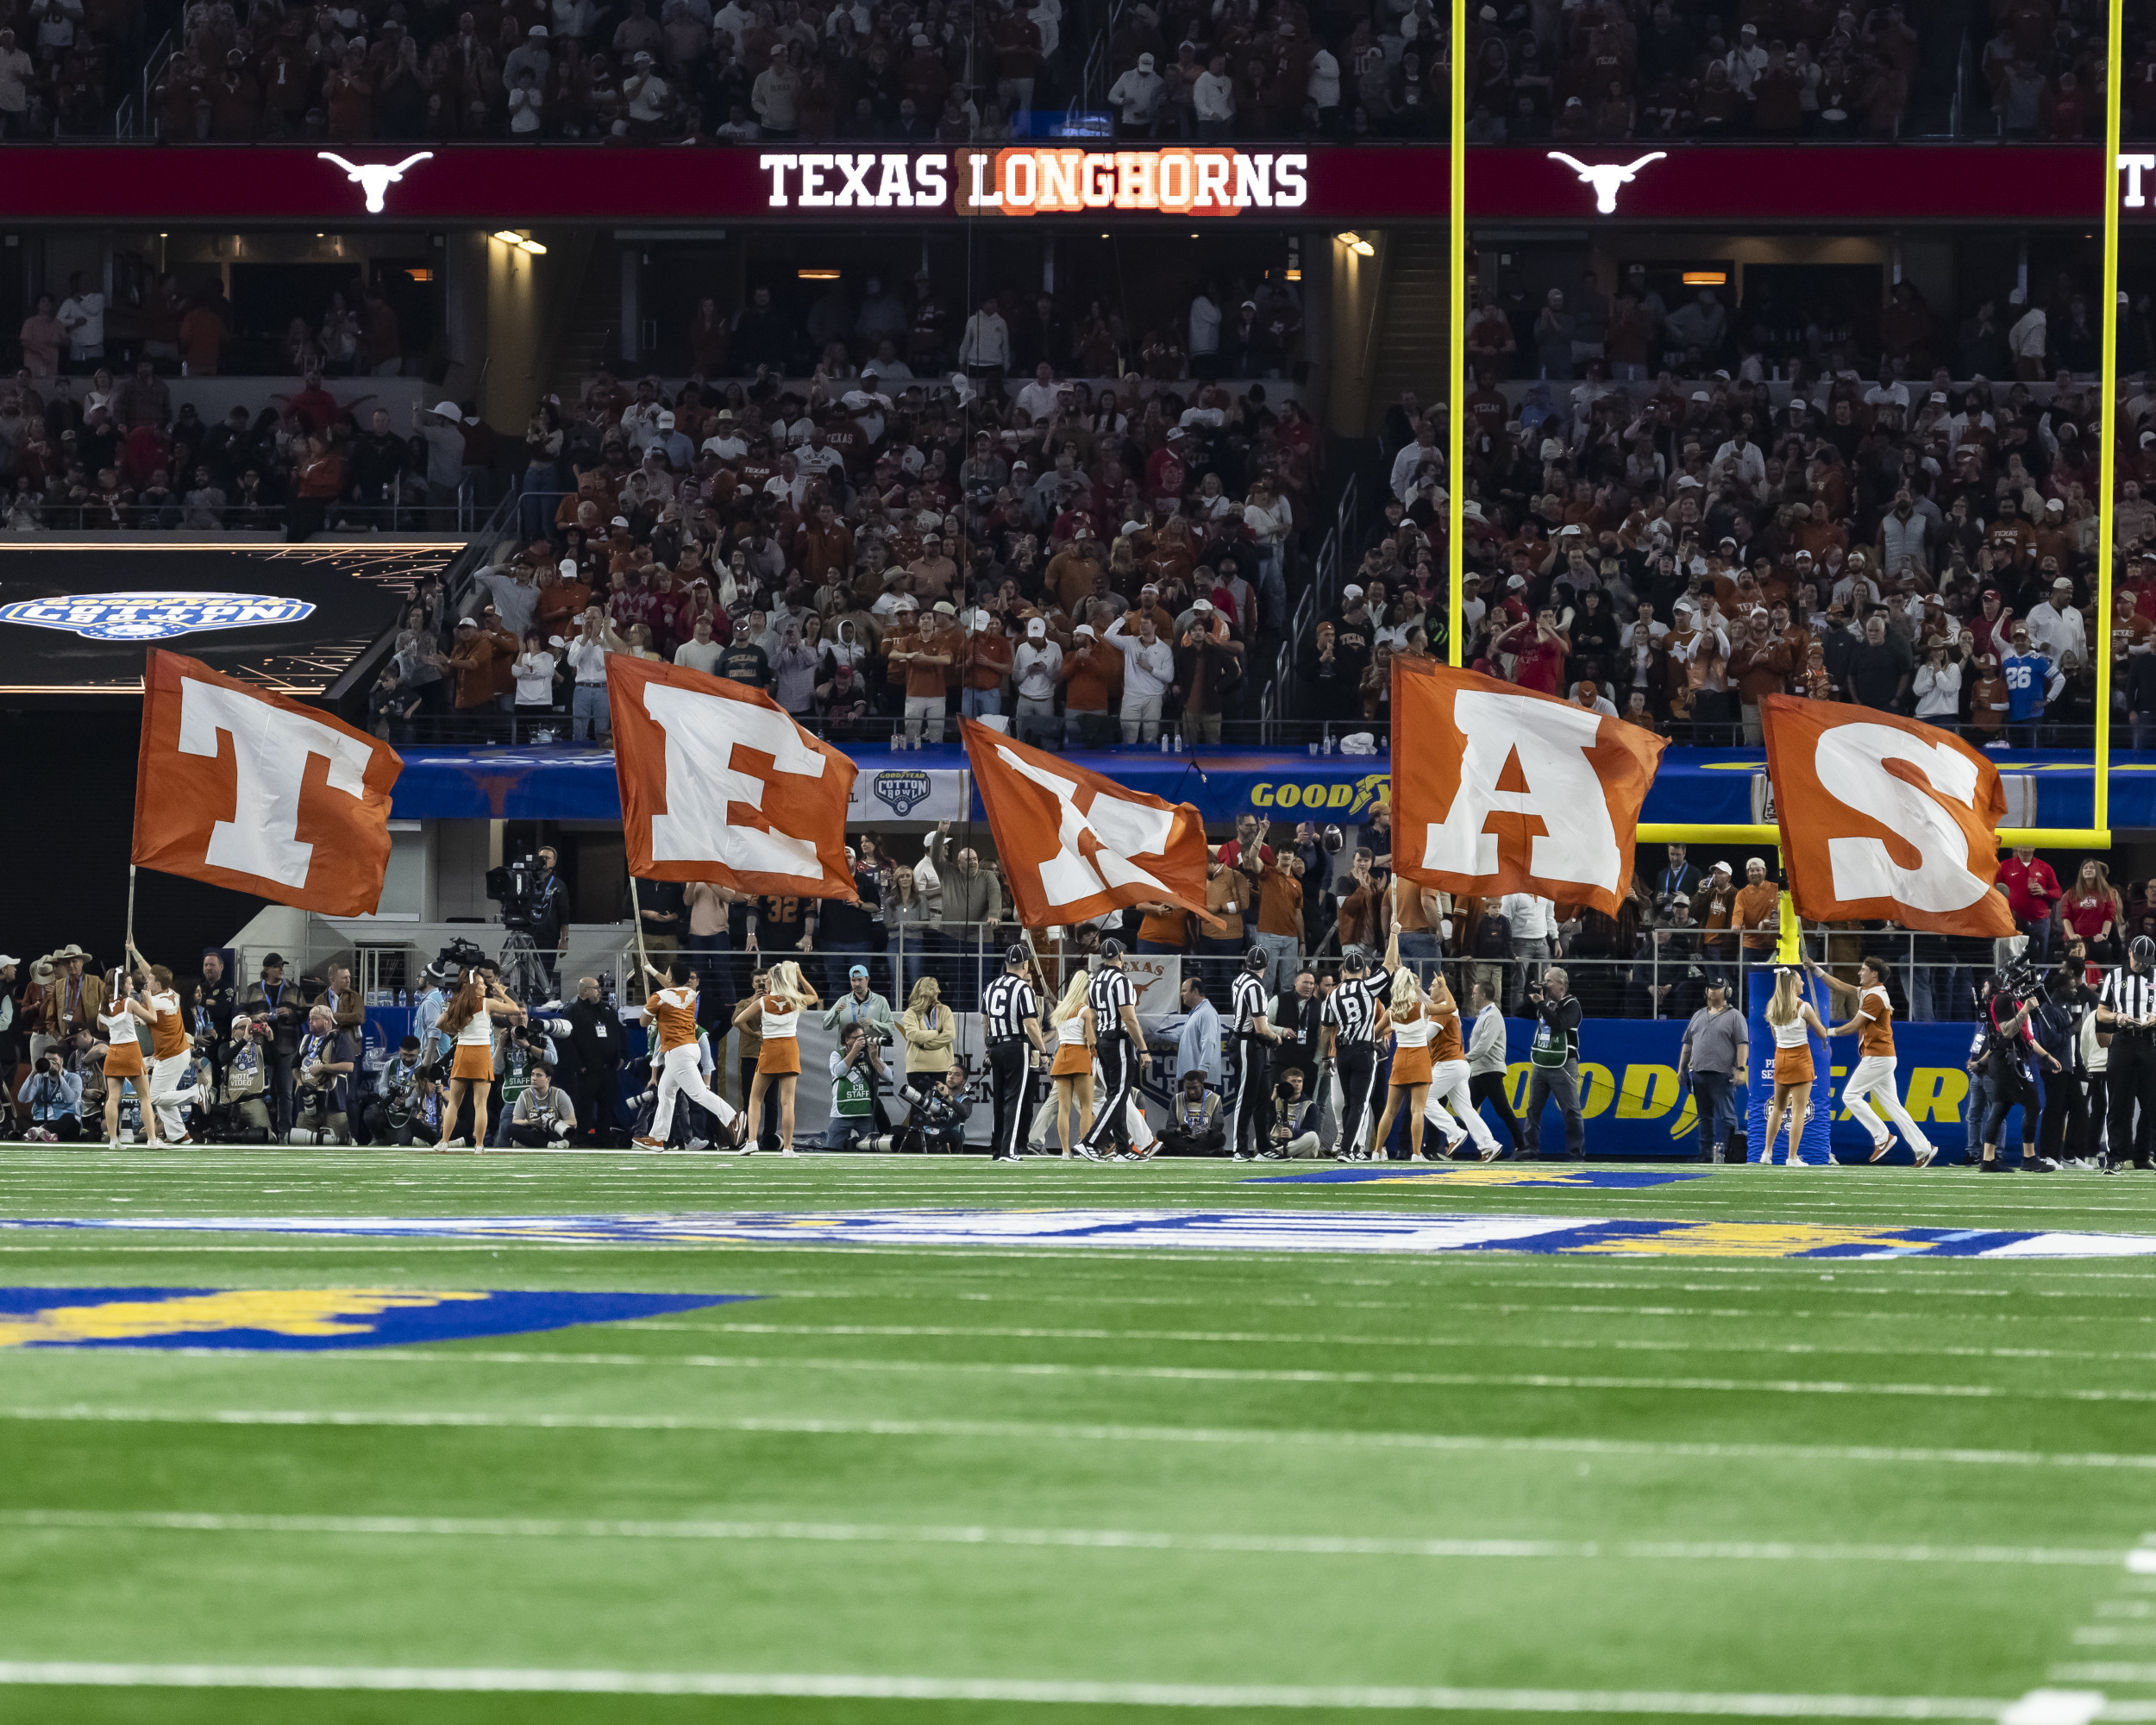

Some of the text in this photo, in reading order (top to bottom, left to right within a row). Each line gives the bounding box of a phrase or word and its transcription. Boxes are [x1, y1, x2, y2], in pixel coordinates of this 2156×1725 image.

[760, 154, 1307, 208] TEXAS LONGHORNS
[2115, 154, 2156, 208] T
[1473, 403, 1501, 414] TEXAS
[826, 433, 853, 444] TEXAS
[804, 454, 830, 462] TEXAS
[22, 605, 287, 622] COTTON
[1737, 602, 1760, 612] TEXA
[66, 613, 229, 624] BOWL
[1339, 634, 1365, 646] TEXAS
[728, 655, 759, 664] TEXAS
[2006, 666, 2032, 690] 26
[178, 675, 373, 890] T
[642, 681, 827, 881] E
[878, 780, 927, 795] COTTON
[887, 788, 918, 799] BOWL
[1421, 688, 1621, 896] A
[1814, 722, 1990, 913] S
[767, 895, 799, 923] 32
[1122, 961, 1165, 975] EXAS
[990, 988, 1007, 1016] C
[1095, 983, 1107, 1008] L
[1342, 996, 1363, 1024] B
[846, 1090, 869, 1099] STAFF
